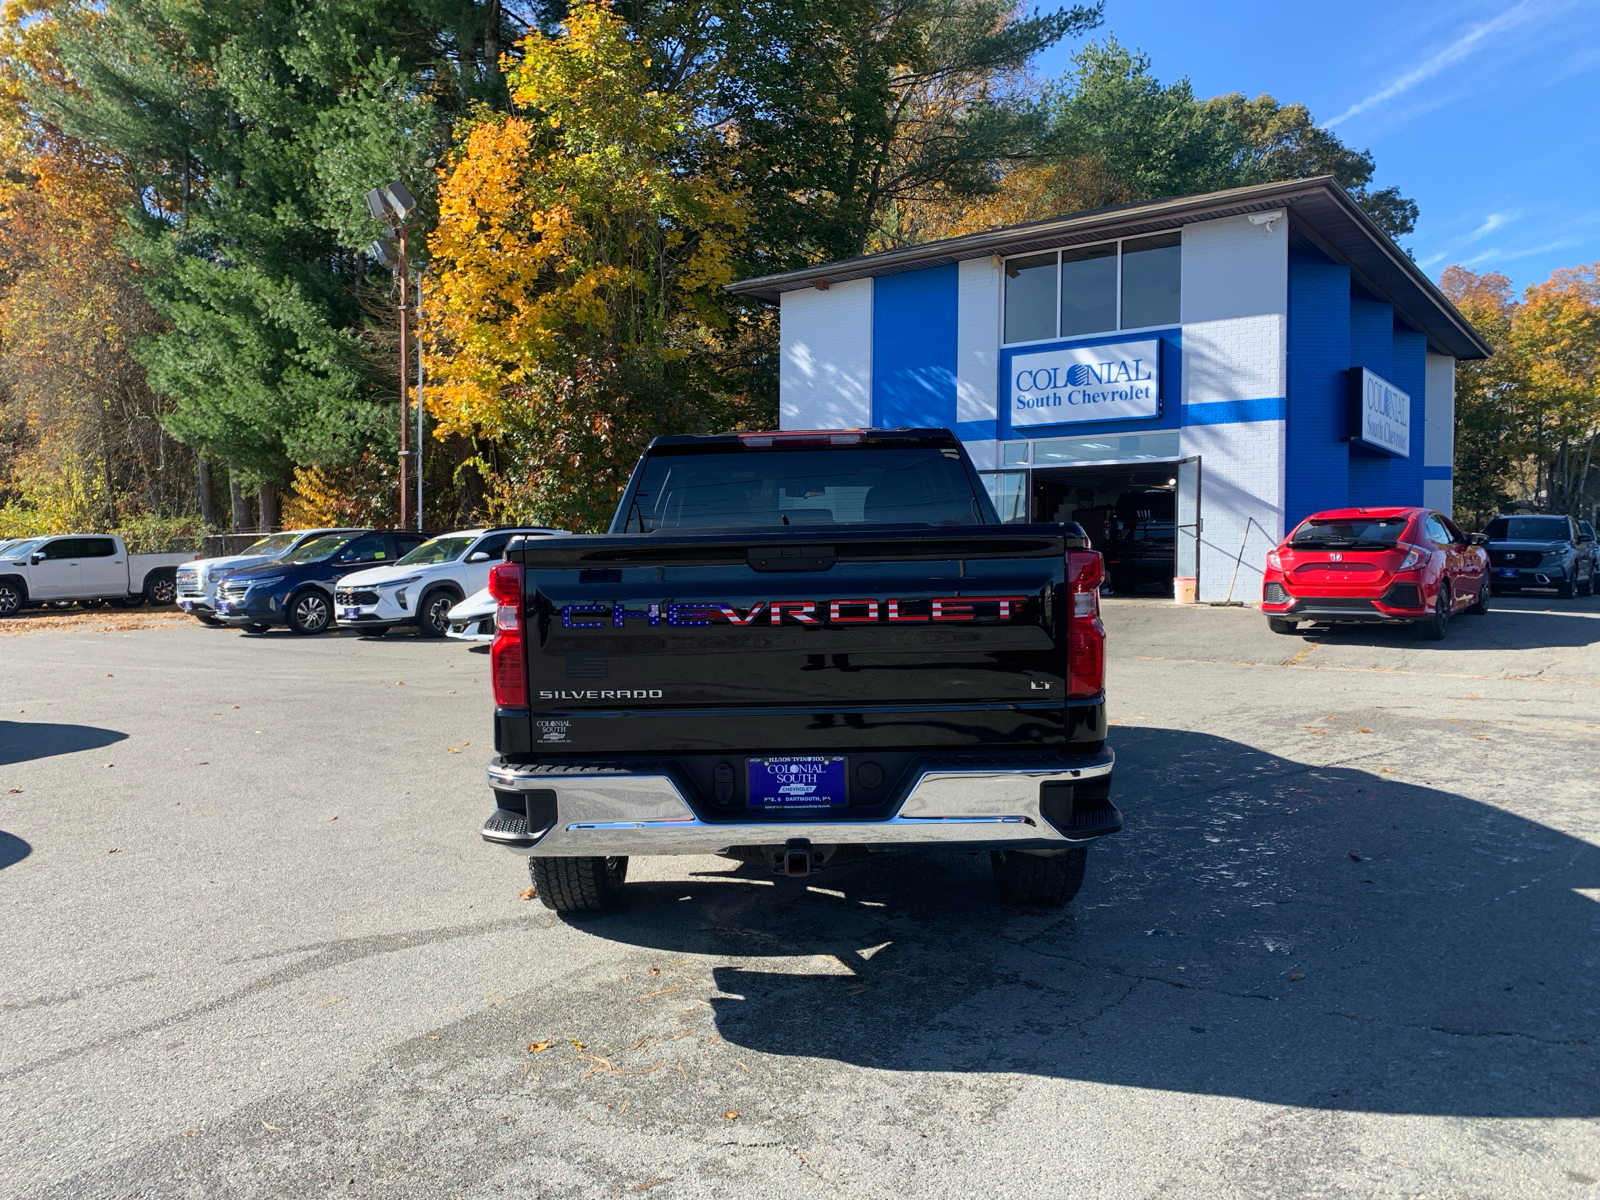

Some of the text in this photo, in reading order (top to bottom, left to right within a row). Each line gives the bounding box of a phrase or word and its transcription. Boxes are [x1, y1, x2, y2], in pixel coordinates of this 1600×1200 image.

[1016, 359, 1151, 392] COLONIAL
[1016, 385, 1151, 410] South Chevrolet
[1367, 378, 1407, 427] COLONIAL
[1367, 413, 1407, 450] South Chevrolet
[562, 596, 1028, 628] CHEVROLET
[539, 689, 663, 699] SILVERADO
[1030, 681, 1054, 690] LT
[767, 764, 826, 774] COLONIAL
[776, 774, 817, 783] SOUTH
